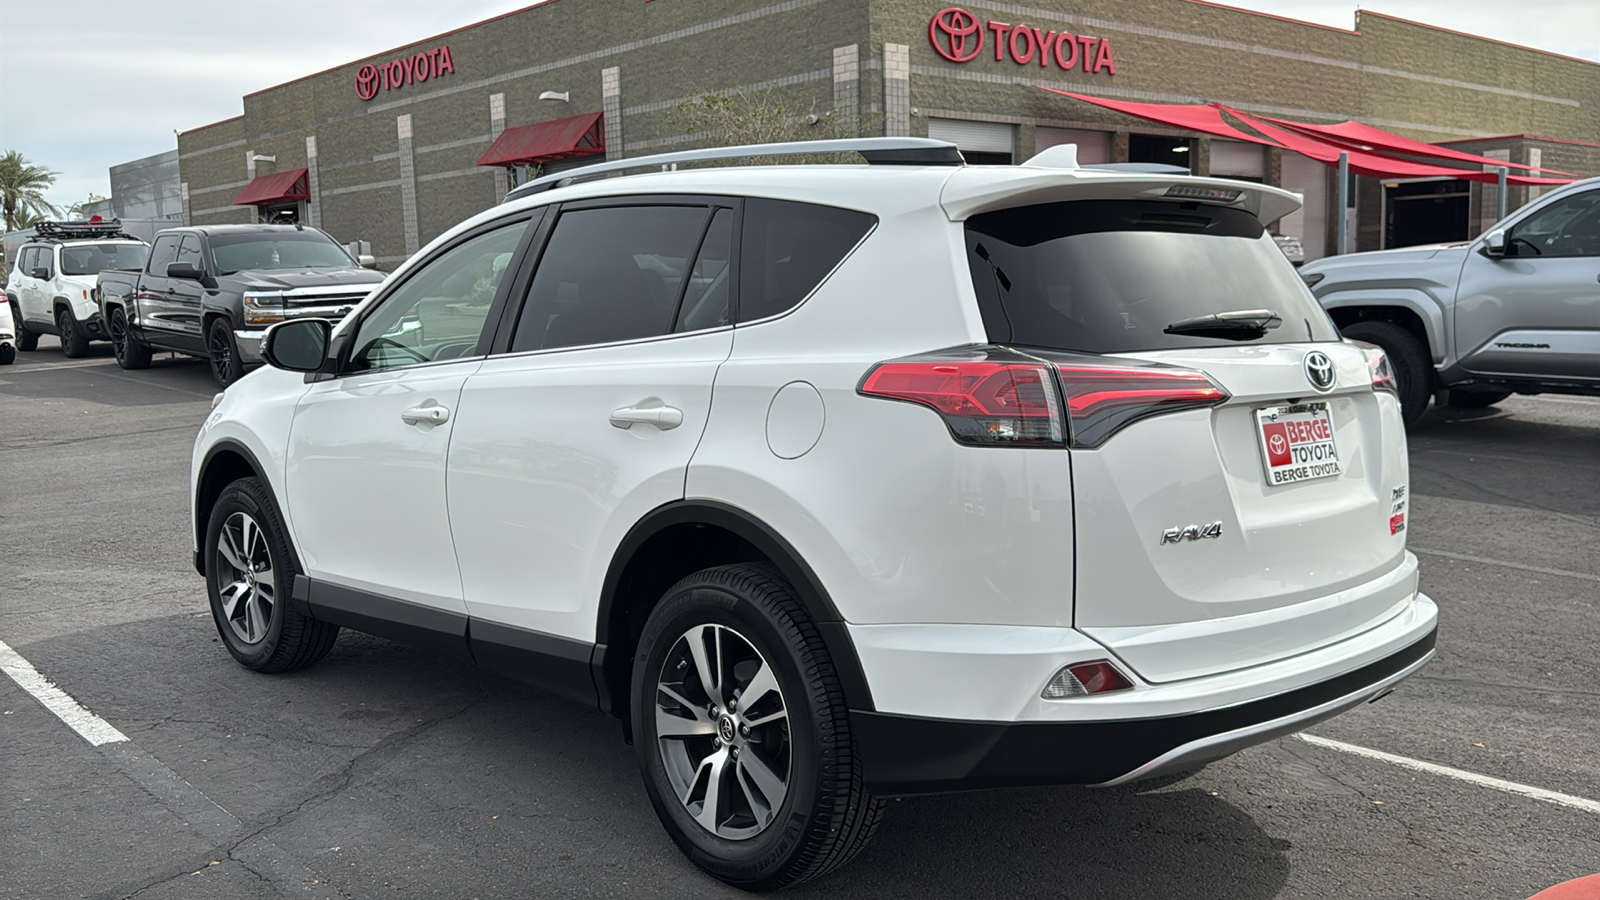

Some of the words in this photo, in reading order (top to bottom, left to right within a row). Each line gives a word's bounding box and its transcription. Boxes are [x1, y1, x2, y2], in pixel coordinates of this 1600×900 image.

[987, 20, 1116, 75] TOYOTA
[380, 45, 454, 91] TOYOTA
[1286, 418, 1331, 443] BERGE
[1292, 443, 1337, 464] TOYOTA
[1274, 466, 1309, 483] BERGE
[1309, 462, 1341, 477] TOYOTA
[1160, 520, 1223, 546] RAV4
